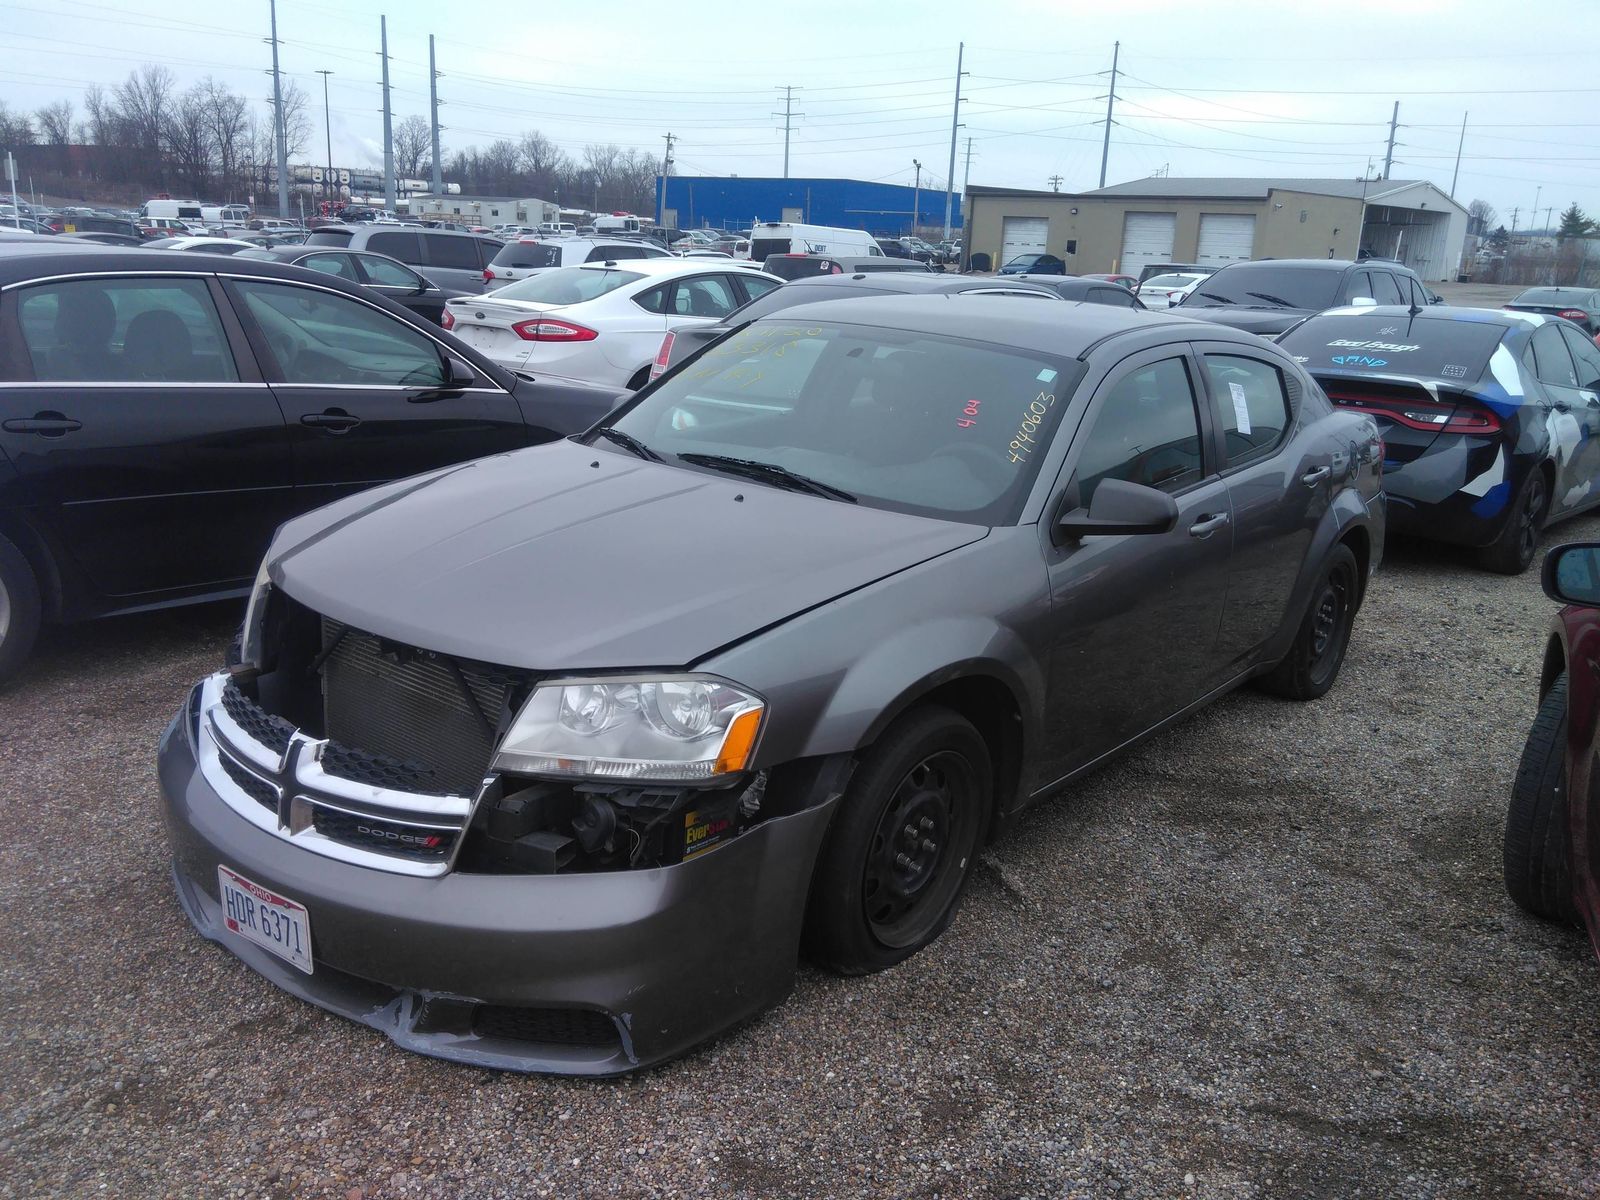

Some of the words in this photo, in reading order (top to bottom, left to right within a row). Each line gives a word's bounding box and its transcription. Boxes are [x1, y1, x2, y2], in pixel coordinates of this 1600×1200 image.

[1006, 391, 1055, 463] 4940603
[357, 825, 428, 845] DODGE
[249, 884, 272, 902] OHIO
[224, 885, 257, 930] HDR
[260, 904, 303, 954] 6371
